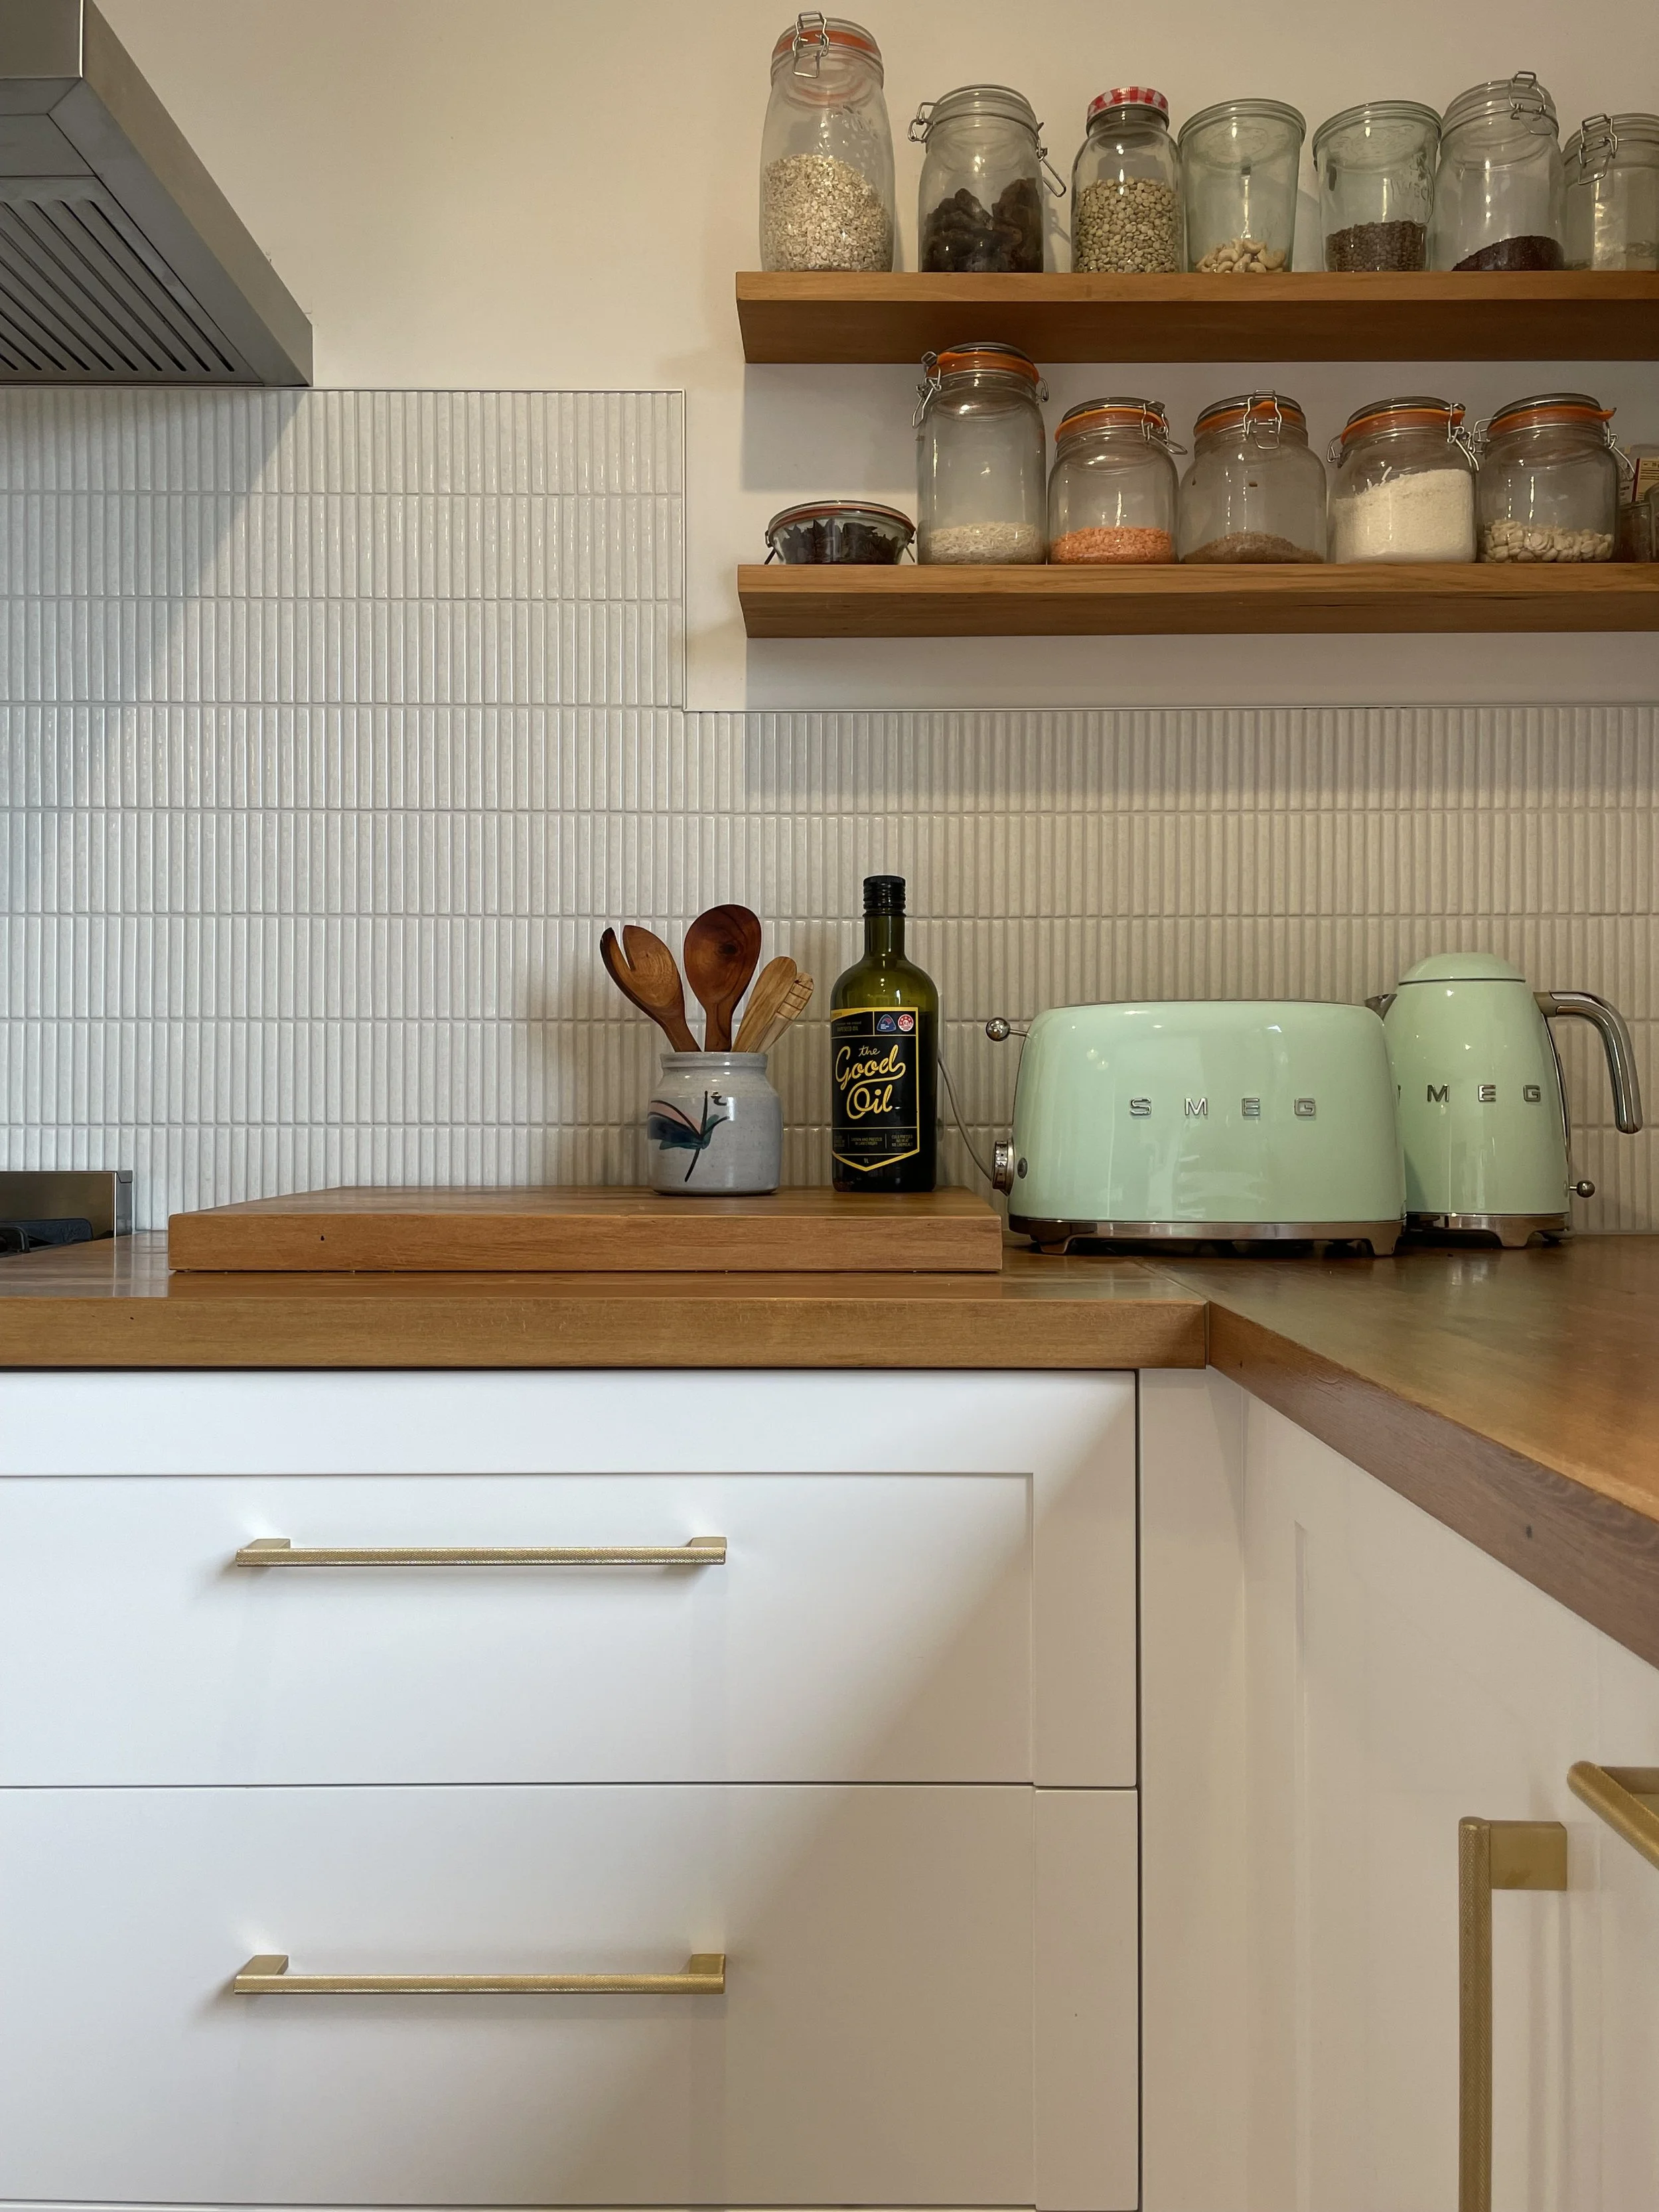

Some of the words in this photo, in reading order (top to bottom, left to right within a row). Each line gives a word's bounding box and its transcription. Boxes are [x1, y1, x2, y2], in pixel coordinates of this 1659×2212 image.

[859, 1045, 880, 1057] the
[835, 1044, 906, 1090] Good
[846, 1084, 893, 1120] Oil
[1398, 1084, 1541, 1102] MEG
[1129, 1097, 1316, 1116] SMEG
